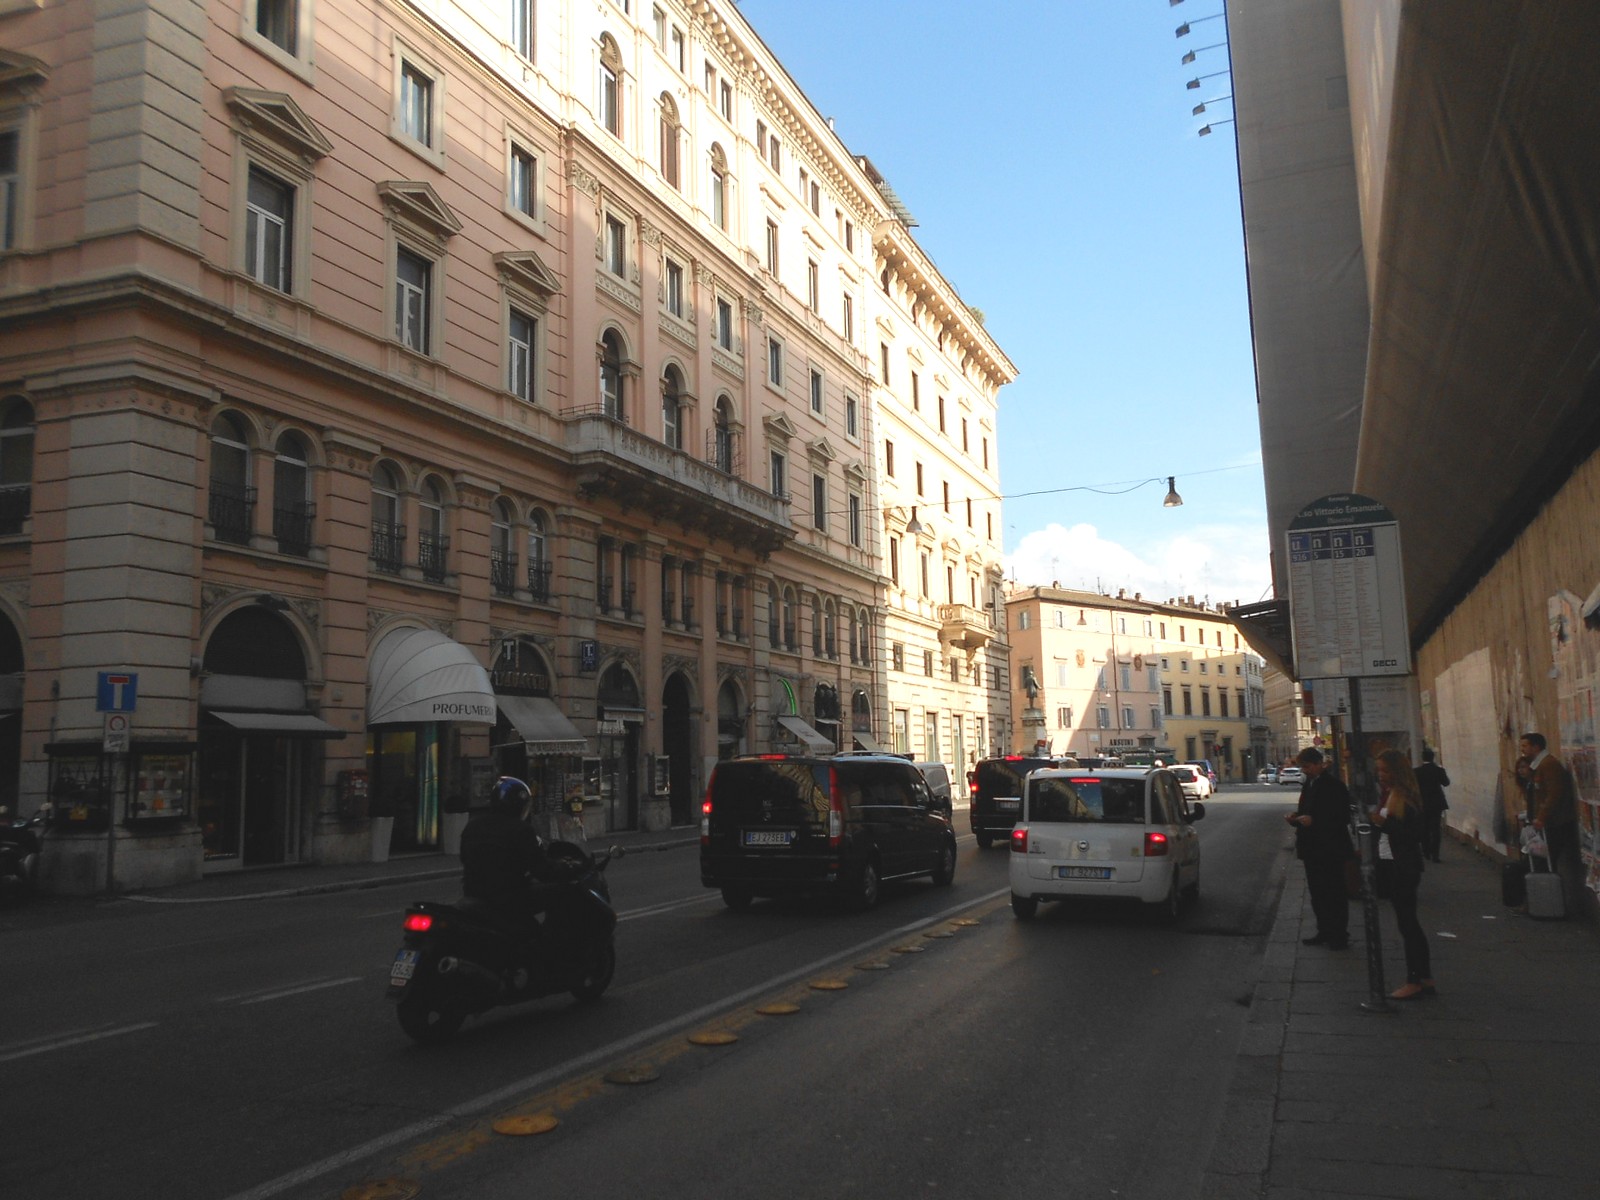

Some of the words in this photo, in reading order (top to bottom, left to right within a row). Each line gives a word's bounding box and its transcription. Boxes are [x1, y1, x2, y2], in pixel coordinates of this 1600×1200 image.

[1313, 507, 1344, 517] Vittorio
[1345, 503, 1385, 514] Emanuele
[1312, 538, 1322, 549] n
[1333, 536, 1343, 547] n
[1354, 535, 1365, 546] n
[1356, 548, 1367, 557] 20
